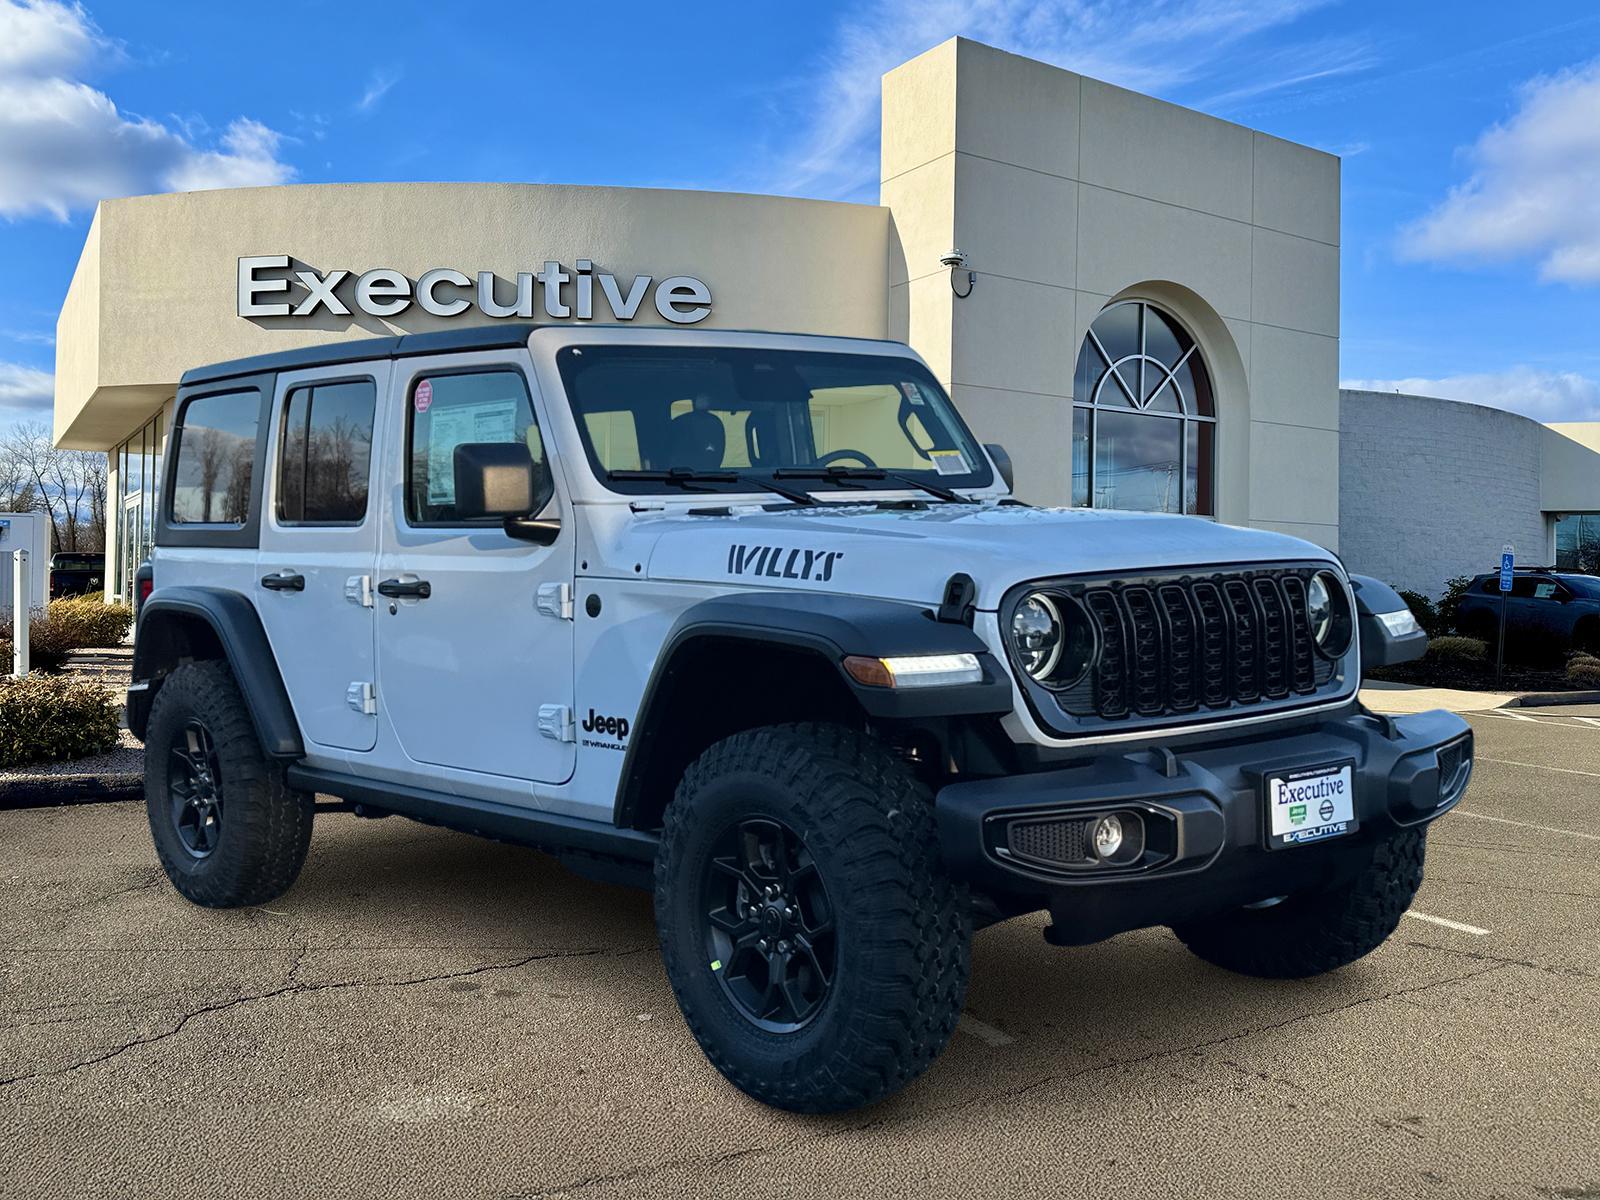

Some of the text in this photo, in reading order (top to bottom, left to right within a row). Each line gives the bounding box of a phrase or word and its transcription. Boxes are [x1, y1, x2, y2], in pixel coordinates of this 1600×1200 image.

[237, 254, 713, 324] Executive
[728, 544, 844, 582] WILLYS
[582, 708, 629, 740] Jeep
[1278, 777, 1344, 805] Executive
[1283, 822, 1347, 842] EXECUTIVE
